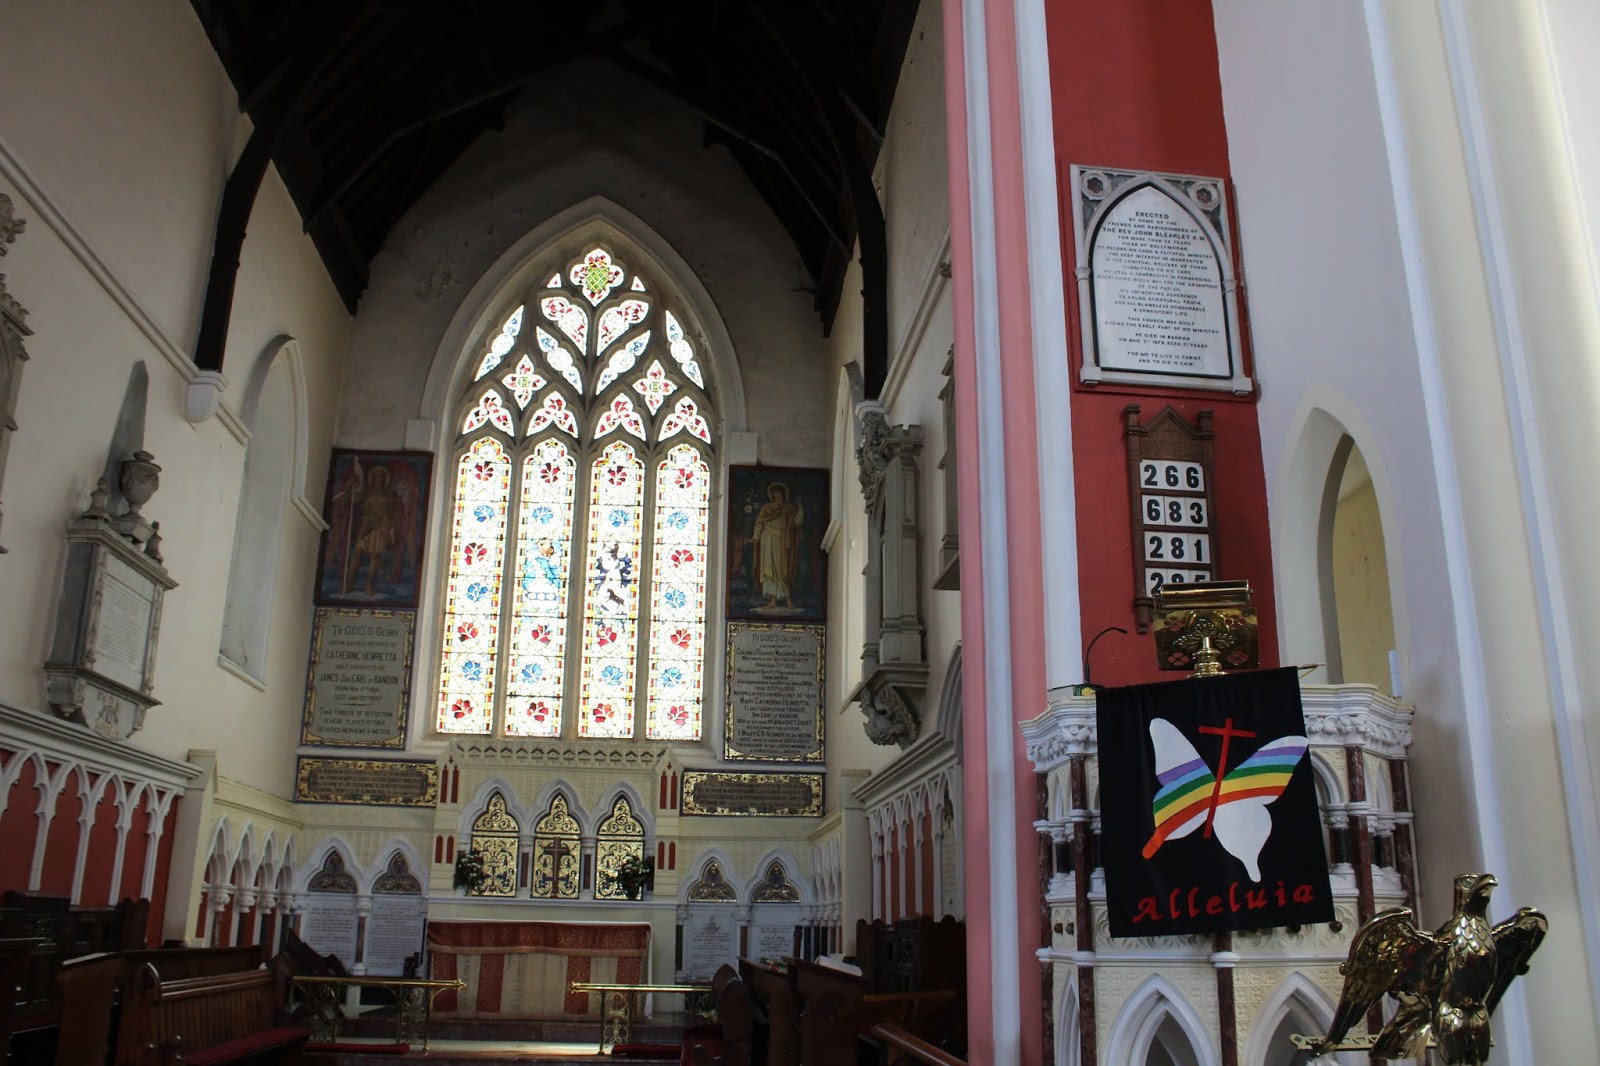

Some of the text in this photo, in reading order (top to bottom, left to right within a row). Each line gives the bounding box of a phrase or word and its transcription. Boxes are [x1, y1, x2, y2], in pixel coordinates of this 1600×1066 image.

[1144, 464, 1200, 488] 266
[1147, 500, 1203, 524] 683
[1150, 536, 1202, 562] 281
[1133, 881, 1314, 922] Alleluia
